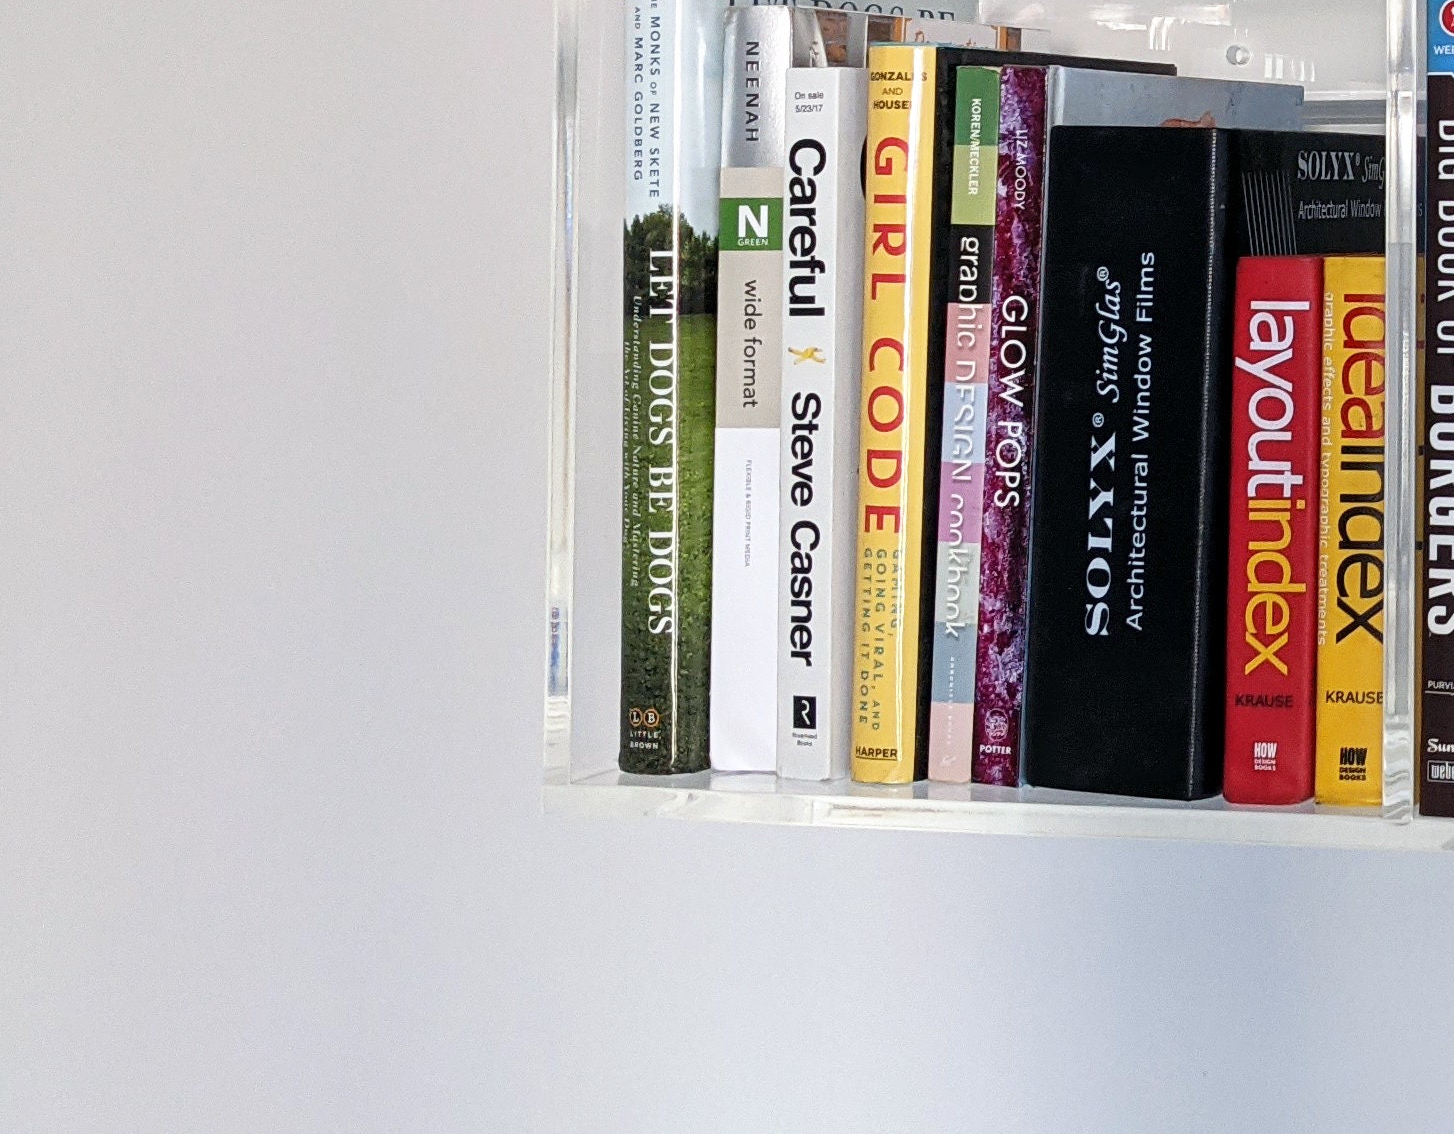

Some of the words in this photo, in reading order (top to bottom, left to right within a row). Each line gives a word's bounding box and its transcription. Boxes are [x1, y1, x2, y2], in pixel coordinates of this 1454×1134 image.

[634, 37, 643, 84] MARC
[650, 16, 661, 76] MONKS
[745, 41, 760, 141] NEENAH
[794, 91, 806, 100] On
[808, 91, 824, 100] sale
[870, 71, 928, 82] GONZALS
[881, 87, 904, 96] AND
[650, 103, 660, 140] NEW
[795, 104, 824, 113] 5/23/17
[873, 100, 912, 110] HOUSE
[633, 91, 643, 181] GOLDBERG
[968, 97, 982, 195] KOREN/MECKLER
[649, 148, 660, 198] SKETE
[1014, 156, 1027, 210] MOODY
[738, 204, 769, 237] N
[788, 138, 827, 316] Careful
[872, 136, 910, 300] GIRL
[1298, 198, 1348, 219] Architectural
[1351, 199, 1382, 218] Window
[737, 237, 769, 247] GREEN
[649, 250, 674, 324] LET
[744, 279, 763, 330] wide
[956, 236, 983, 347] graphic
[1136, 252, 1155, 322] Films
[631, 295, 642, 390] Understanding
[998, 295, 1029, 408] GLOW
[649, 340, 674, 446] DOGS
[743, 336, 762, 408] format
[1132, 334, 1152, 442] Window
[1322, 357, 1336, 411] effects
[632, 393, 641, 440] Canine
[864, 337, 905, 534] CODE
[1321, 418, 1333, 447] and
[632, 445, 642, 489] Nature
[791, 391, 822, 507] Steve
[994, 421, 1023, 508] POPS
[632, 492, 641, 517] and
[648, 463, 674, 513] BE
[630, 522, 641, 587] Mastering
[1126, 454, 1149, 631] Architectural
[648, 529, 674, 635] DOGS
[790, 520, 821, 667] Casner
[861, 547, 873, 633] GETTING
[875, 548, 888, 612] GOING
[1318, 554, 1330, 646] treatments
[861, 643, 870, 660] IT
[859, 670, 870, 724] DONE
[872, 699, 881, 730] AND
[1235, 694, 1294, 708] KRAUSE
[1325, 690, 1384, 705] KRAUSE
[629, 741, 659, 749] BROWN
[855, 745, 898, 758] HARPER
[979, 744, 1012, 755] POTTER
[1254, 741, 1277, 758] HOW
[1339, 747, 1368, 766] HOW
